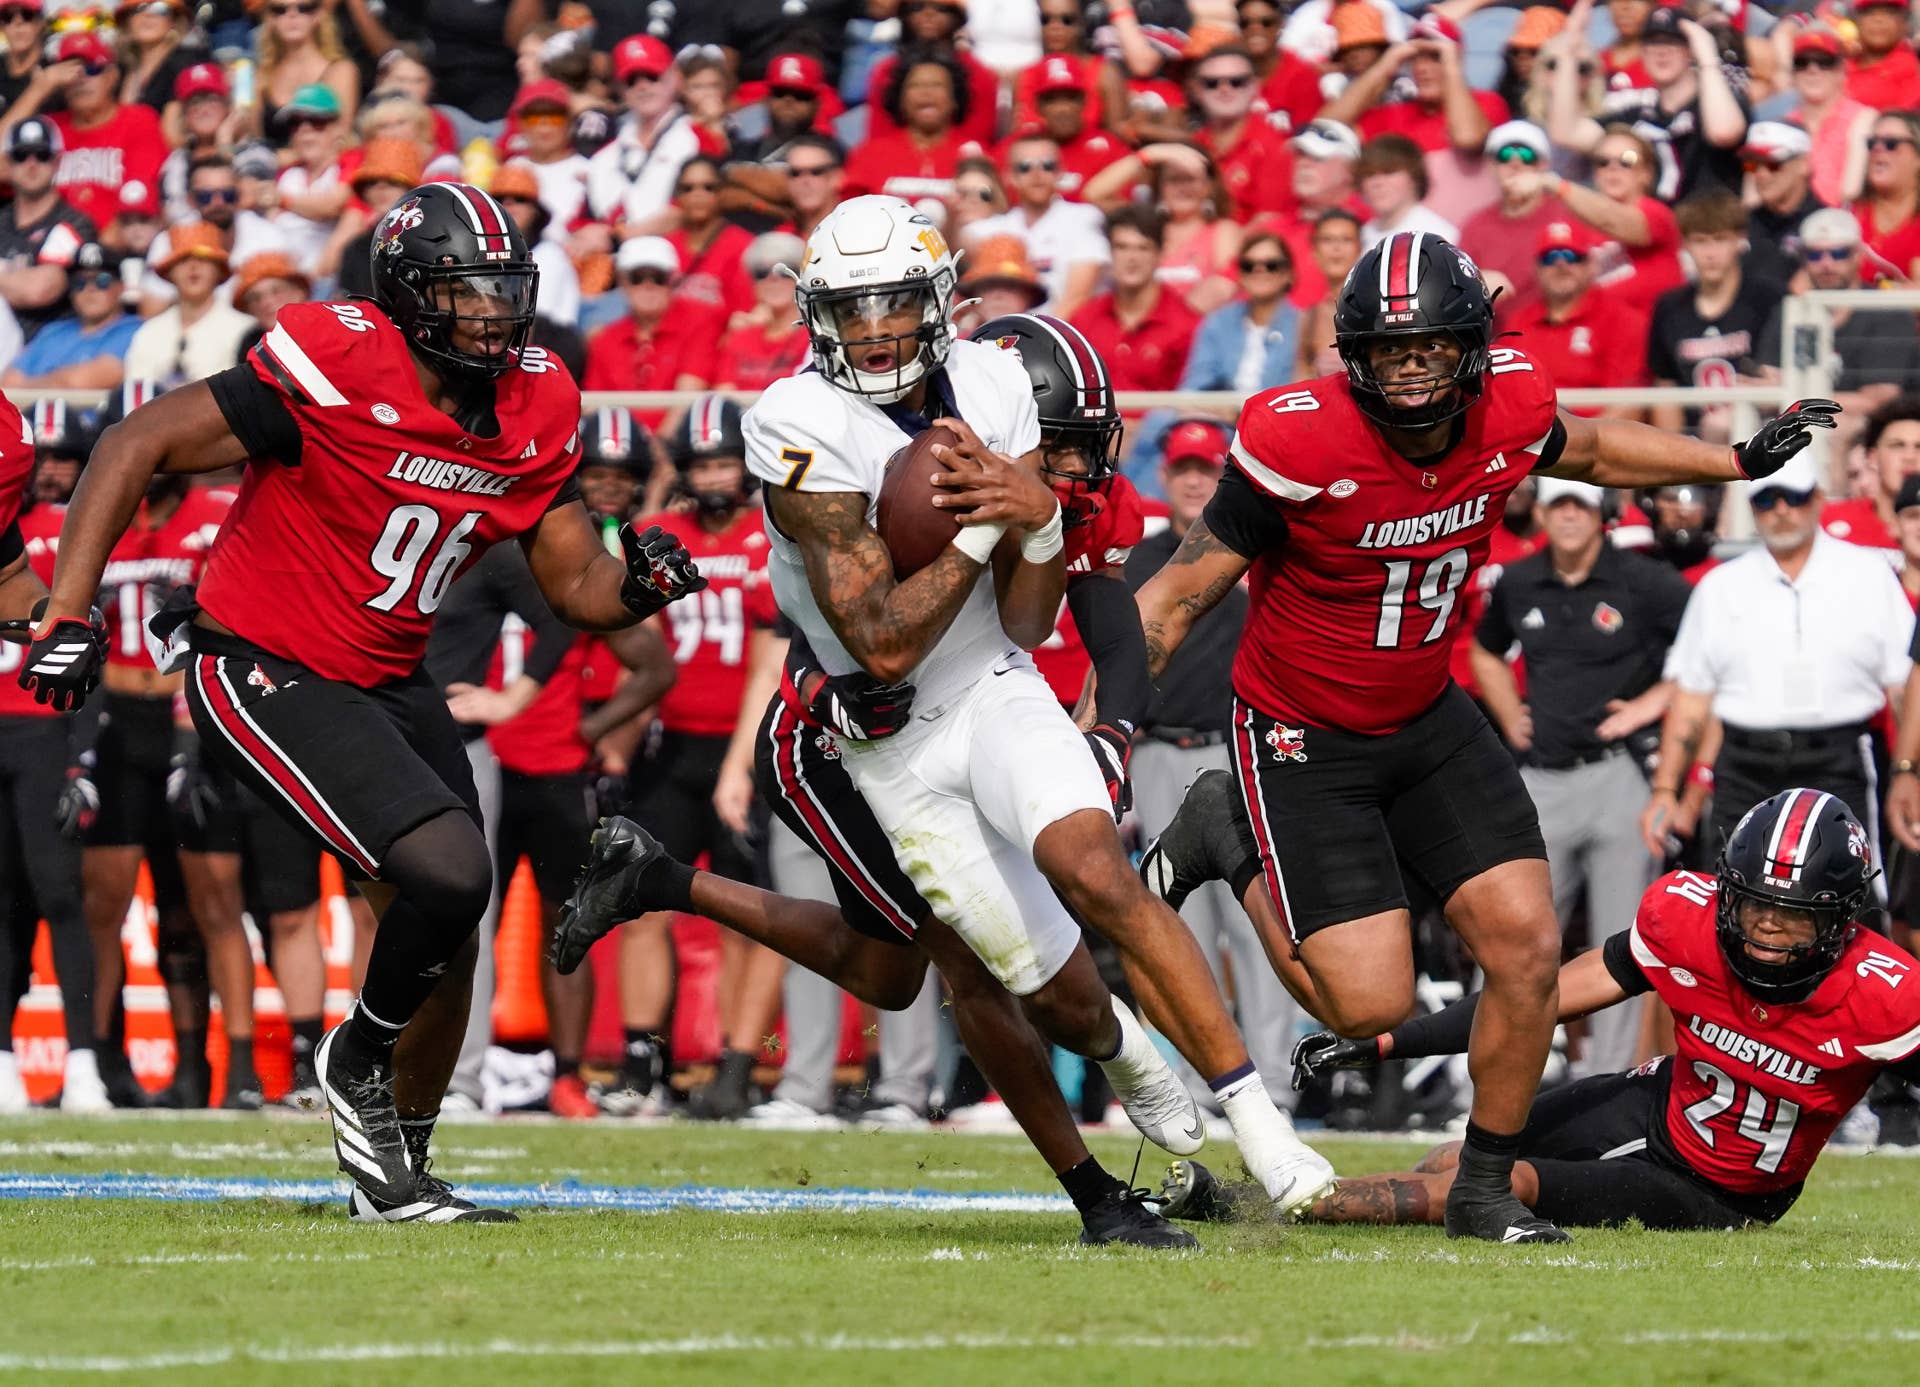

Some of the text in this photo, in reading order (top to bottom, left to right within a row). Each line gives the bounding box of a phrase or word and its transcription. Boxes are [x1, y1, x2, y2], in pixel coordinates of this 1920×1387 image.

[486, 251, 511, 261] THE VILLE
[321, 303, 377, 333] 96
[1385, 312, 1414, 323] THE VILLE
[1267, 390, 1321, 414] 19
[386, 450, 522, 496] LOUISVILLE
[781, 447, 815, 492] 7
[1355, 492, 1491, 549] LOUISVILLE
[365, 504, 484, 615] 96
[1375, 546, 1469, 648] 19
[1763, 876, 1793, 889] THE VILLE
[1856, 950, 1910, 989] 24
[1688, 1014, 1823, 1086] LOUISVILLE
[1683, 1060, 1800, 1174] 24
